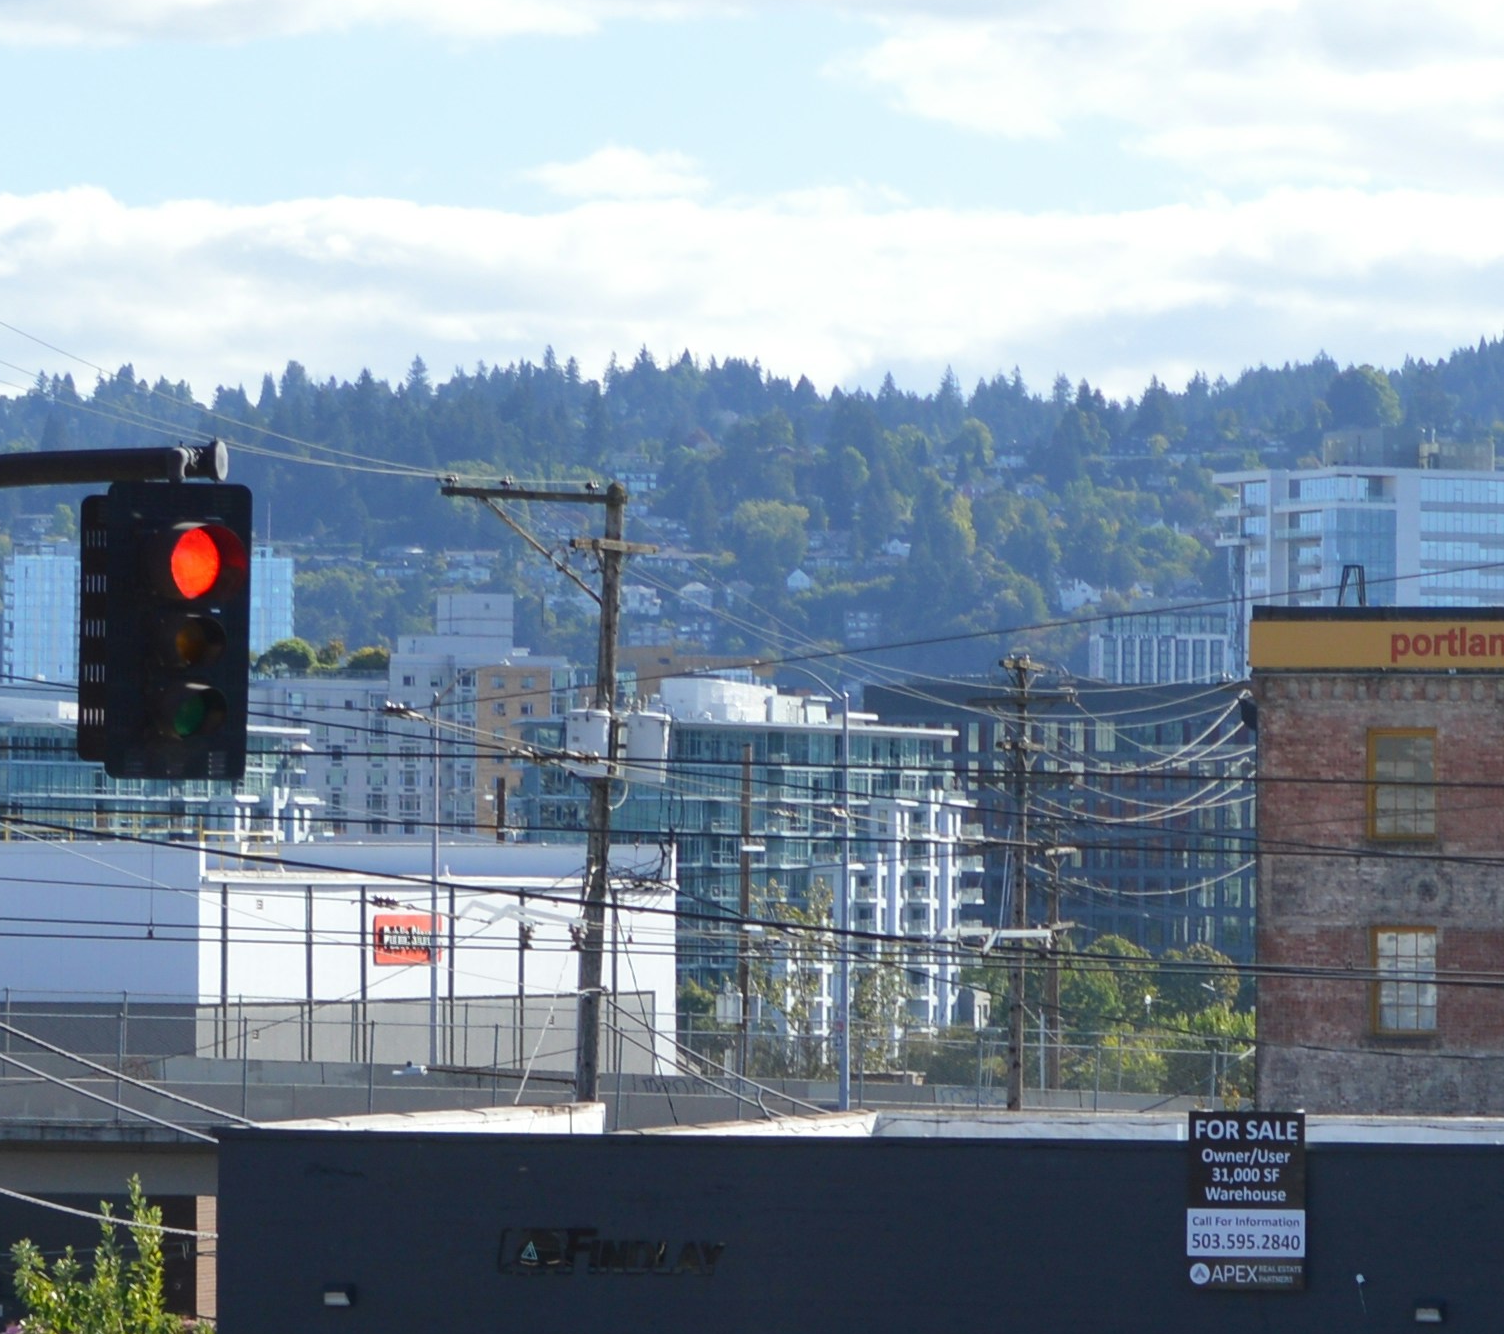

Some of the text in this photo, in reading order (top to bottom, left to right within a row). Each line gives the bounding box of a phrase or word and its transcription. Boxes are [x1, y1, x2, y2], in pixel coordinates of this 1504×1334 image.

[1195, 1119, 1299, 1141] FOR SALE
[1201, 1147, 1291, 1166] Owner/User
[1211, 1167, 1280, 1185] 31,000 SF
[1205, 1186, 1287, 1202] Warehouse
[1192, 1216, 1300, 1228] Call For Information
[1192, 1233, 1301, 1251] 503.595.2840
[1211, 1265, 1258, 1283] APEX
